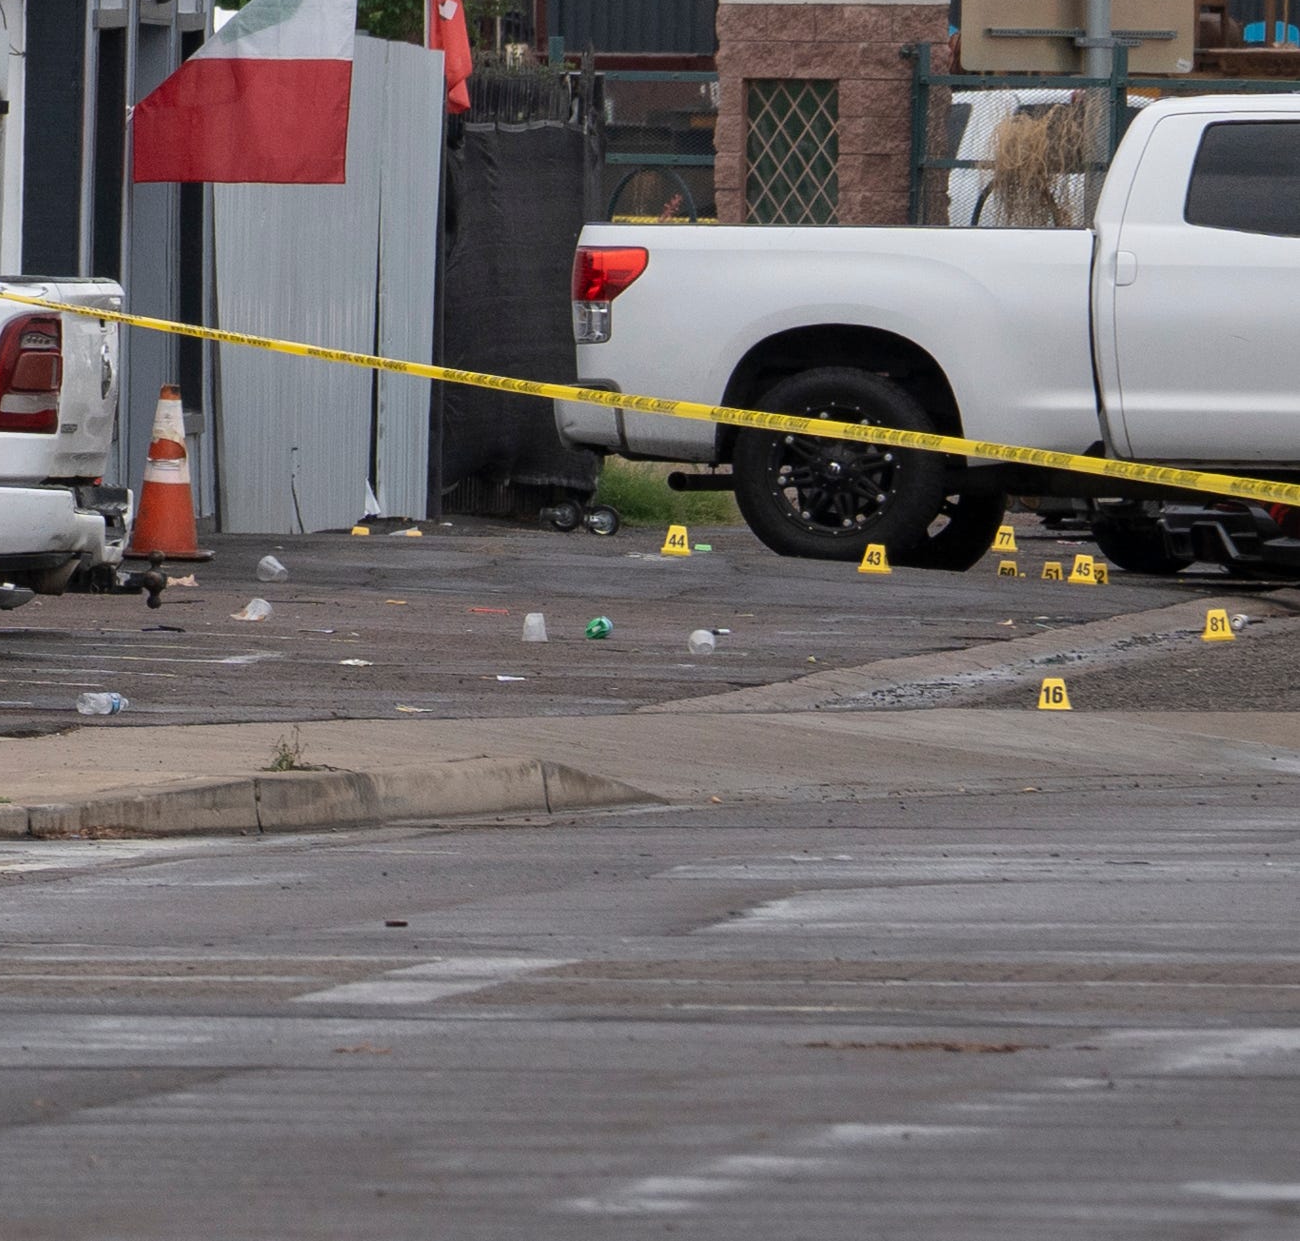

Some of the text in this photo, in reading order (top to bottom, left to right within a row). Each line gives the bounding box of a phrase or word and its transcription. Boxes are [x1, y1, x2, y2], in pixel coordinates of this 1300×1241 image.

[668, 534, 685, 548] 44
[999, 533, 1012, 544] 77
[866, 551, 881, 566] 43
[1044, 568, 1060, 580] 51
[1075, 562, 1090, 576] 45
[1210, 617, 1226, 632] 81
[1043, 686, 1063, 704] 16
